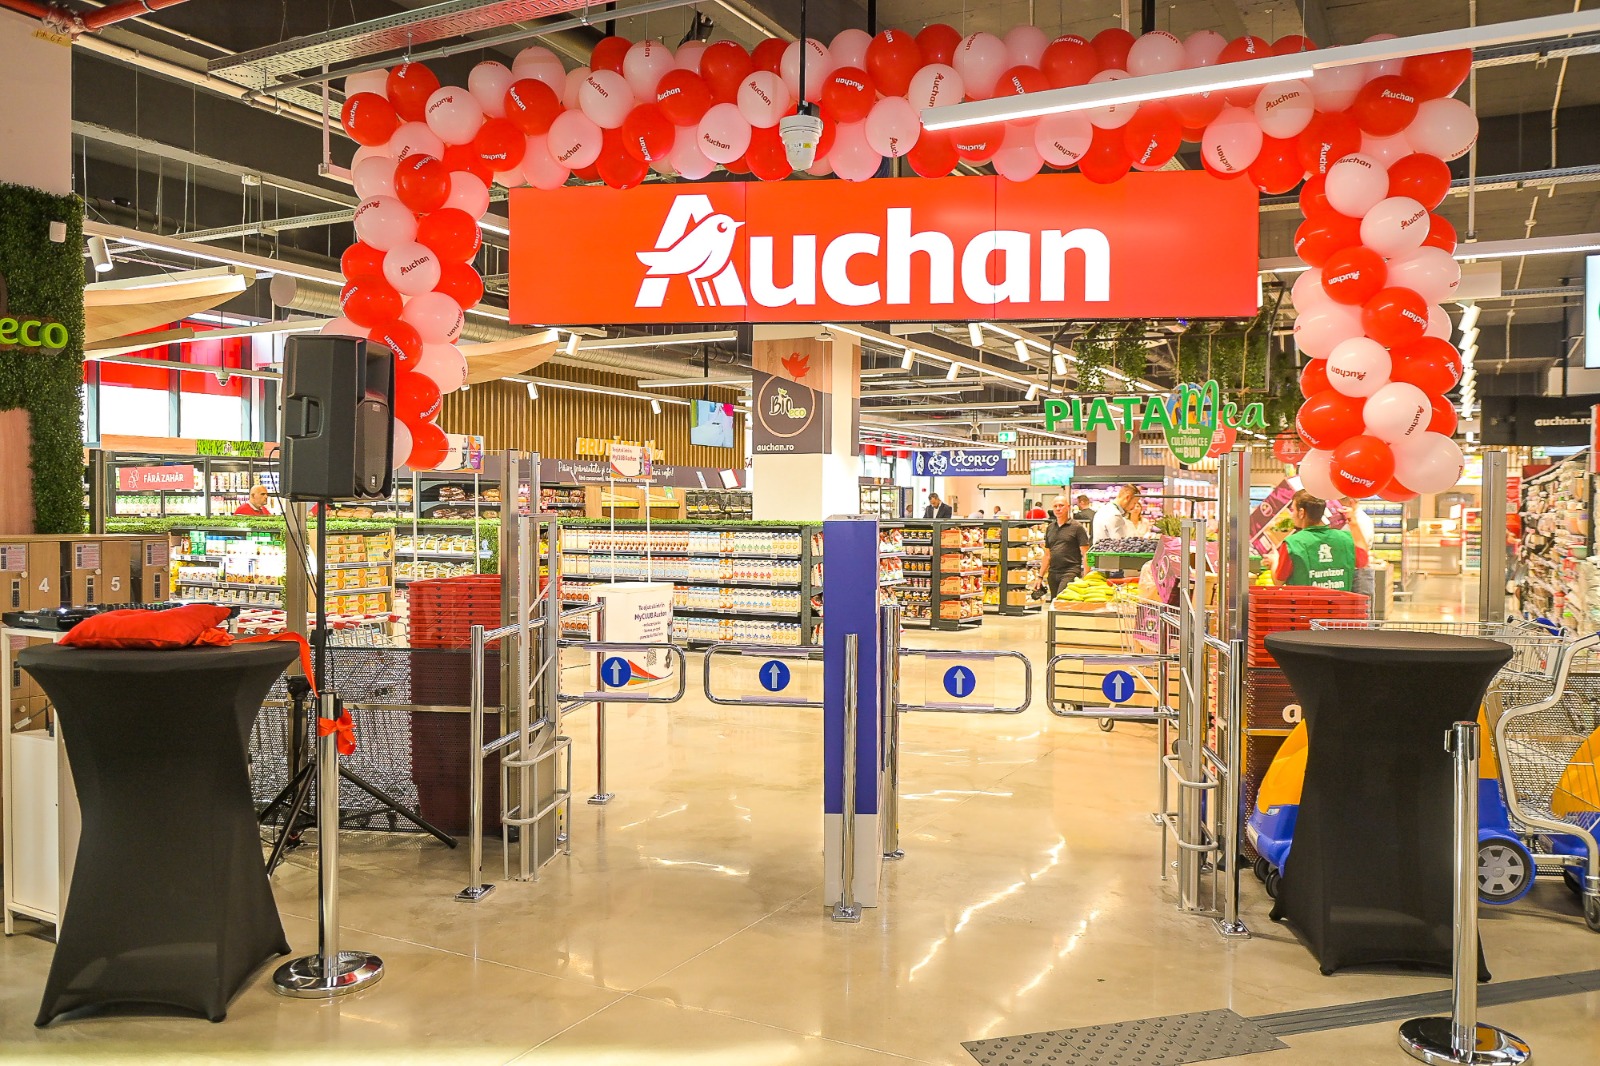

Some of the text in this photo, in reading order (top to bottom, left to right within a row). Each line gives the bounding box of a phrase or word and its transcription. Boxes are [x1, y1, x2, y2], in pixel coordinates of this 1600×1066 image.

[586, 76, 609, 98] Auchan
[657, 87, 680, 101] Auchan
[749, 81, 771, 106] Auchan
[835, 77, 864, 92] Auchan
[929, 72, 944, 107] Auchan
[1012, 76, 1025, 94] chan
[428, 95, 454, 114] Auchan
[510, 87, 527, 111] Auchan
[1265, 90, 1300, 112] Auchan
[1381, 88, 1415, 103] Auchan
[347, 100, 360, 129] Auchan
[639, 136, 653, 162] Auchan
[703, 133, 730, 150] Auchan
[957, 142, 987, 151] Auchan
[1054, 141, 1080, 159] Auchan
[480, 151, 507, 161] Auchan
[557, 141, 582, 163] Auchan
[1216, 144, 1236, 171] Auchan
[1319, 142, 1332, 174] Auchan
[1335, 157, 1372, 169] Auchan
[1401, 209, 1426, 230] Auchan
[634, 194, 1111, 308] Auchan
[400, 255, 430, 276] Auchan
[1328, 270, 1360, 285] Auchan
[341, 286, 358, 305] uchan
[1402, 308, 1427, 330] Auchan
[384, 335, 408, 361] Auchan
[1331, 365, 1367, 381] Auchan
[419, 397, 440, 419] Auchan
[1044, 396, 1174, 443] PIAȚA
[1405, 405, 1424, 436] Auchan
[1534, 415, 1592, 427] auchan.ro
[756, 442, 794, 451] auchan.ro
[1183, 446, 1201, 458] BUN
[143, 471, 184, 483] FĂRĂ ZAHĂR
[1340, 469, 1375, 488] Auchan
[1308, 568, 1345, 579] Furnizor
[38, 577, 50, 593] 4
[110, 576, 121, 591] 5
